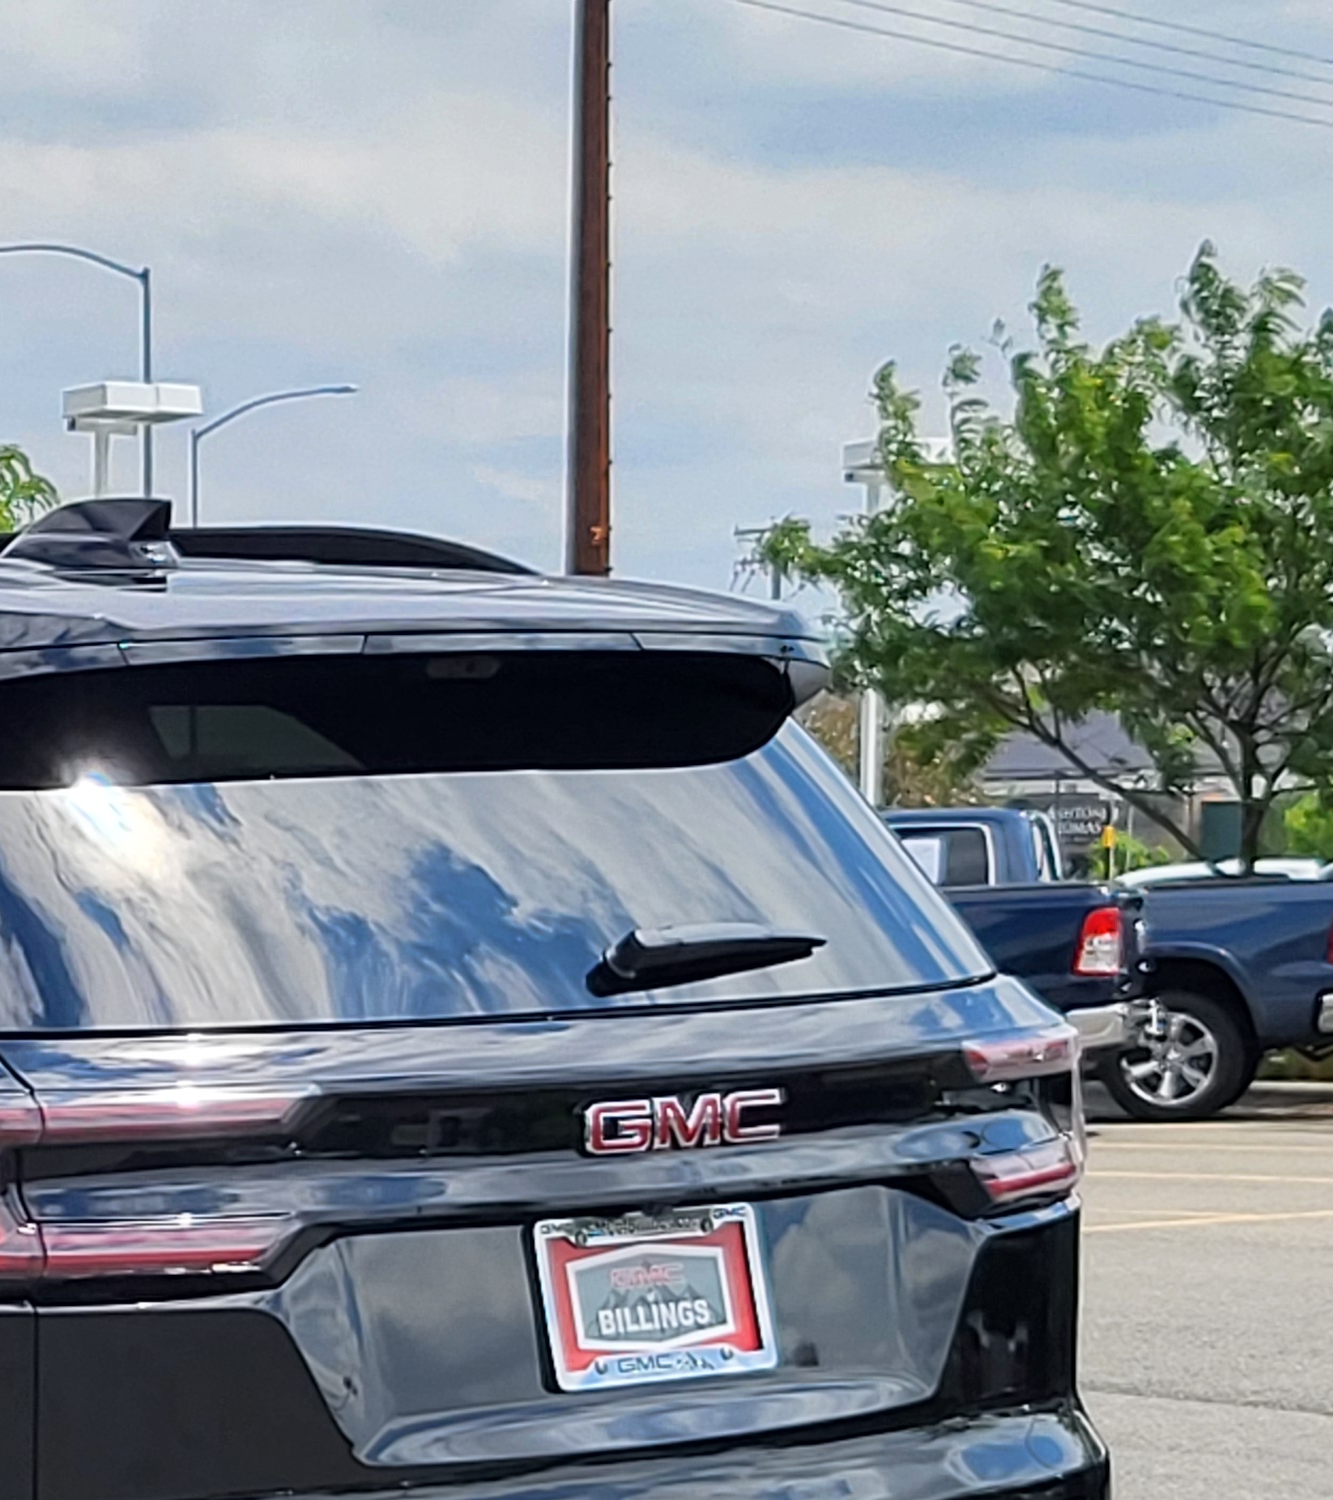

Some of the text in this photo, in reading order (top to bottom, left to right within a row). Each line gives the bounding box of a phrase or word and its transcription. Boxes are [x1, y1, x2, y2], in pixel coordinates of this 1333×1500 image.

[585, 1088, 781, 1155] GMC
[598, 1300, 711, 1336] BILLINGS
[617, 1353, 674, 1374] GMC
